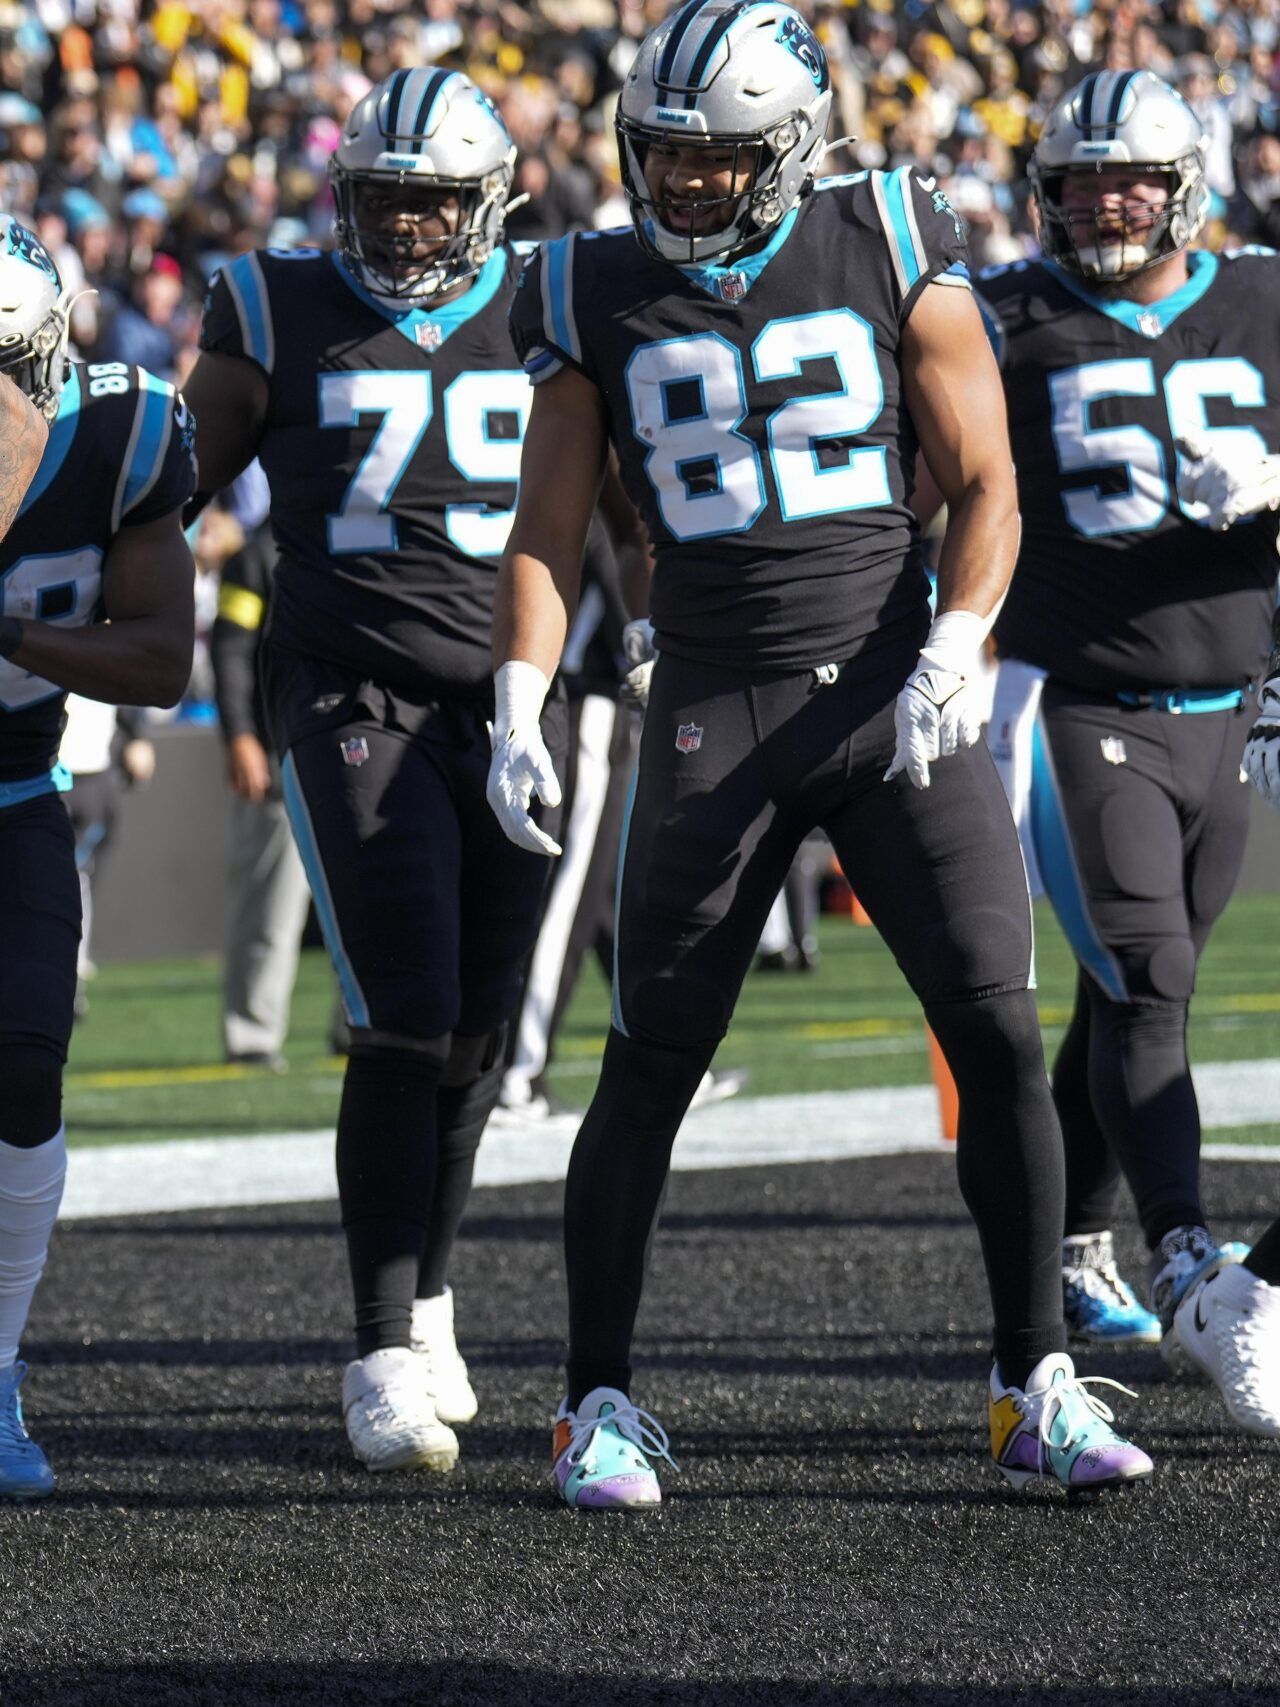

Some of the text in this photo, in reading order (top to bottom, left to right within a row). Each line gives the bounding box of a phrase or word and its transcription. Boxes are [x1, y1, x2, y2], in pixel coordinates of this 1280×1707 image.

[87, 361, 130, 397] 88
[317, 369, 535, 558] 79
[623, 306, 893, 543] 82
[1047, 356, 1268, 539] 56
